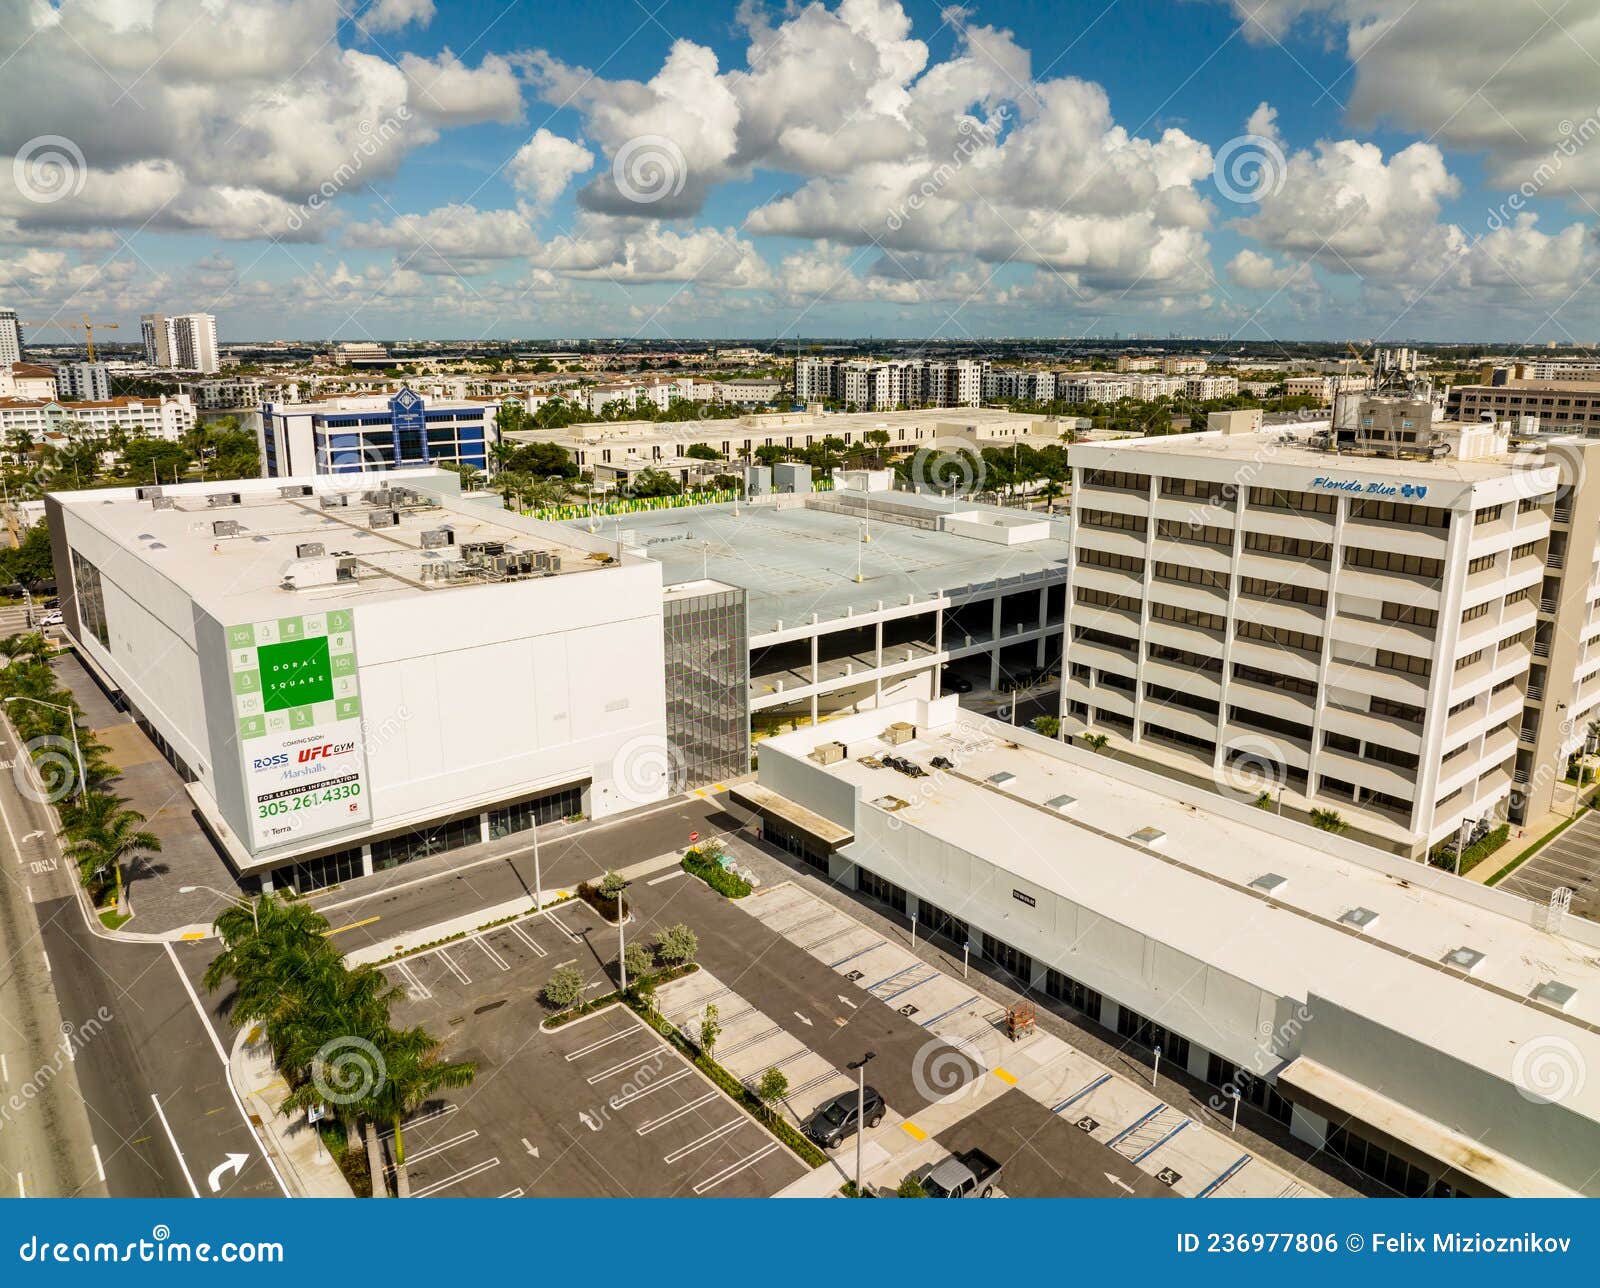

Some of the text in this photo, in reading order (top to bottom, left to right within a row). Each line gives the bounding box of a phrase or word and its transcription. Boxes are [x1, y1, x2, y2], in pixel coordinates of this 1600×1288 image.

[1313, 477, 1397, 496] Florida Blue
[273, 659, 317, 672] DORAL
[270, 675, 324, 690] SQUARE
[282, 735, 325, 748] COMING SOON
[298, 741, 355, 763] UFC GYM
[254, 754, 289, 769] ROSS
[281, 763, 327, 780] Marshalls
[259, 774, 358, 802] FOR LEASING INFORMATION
[258, 783, 361, 818] 305.261.4330
[271, 825, 292, 836] Terra
[30, 857, 59, 874] ONLY
